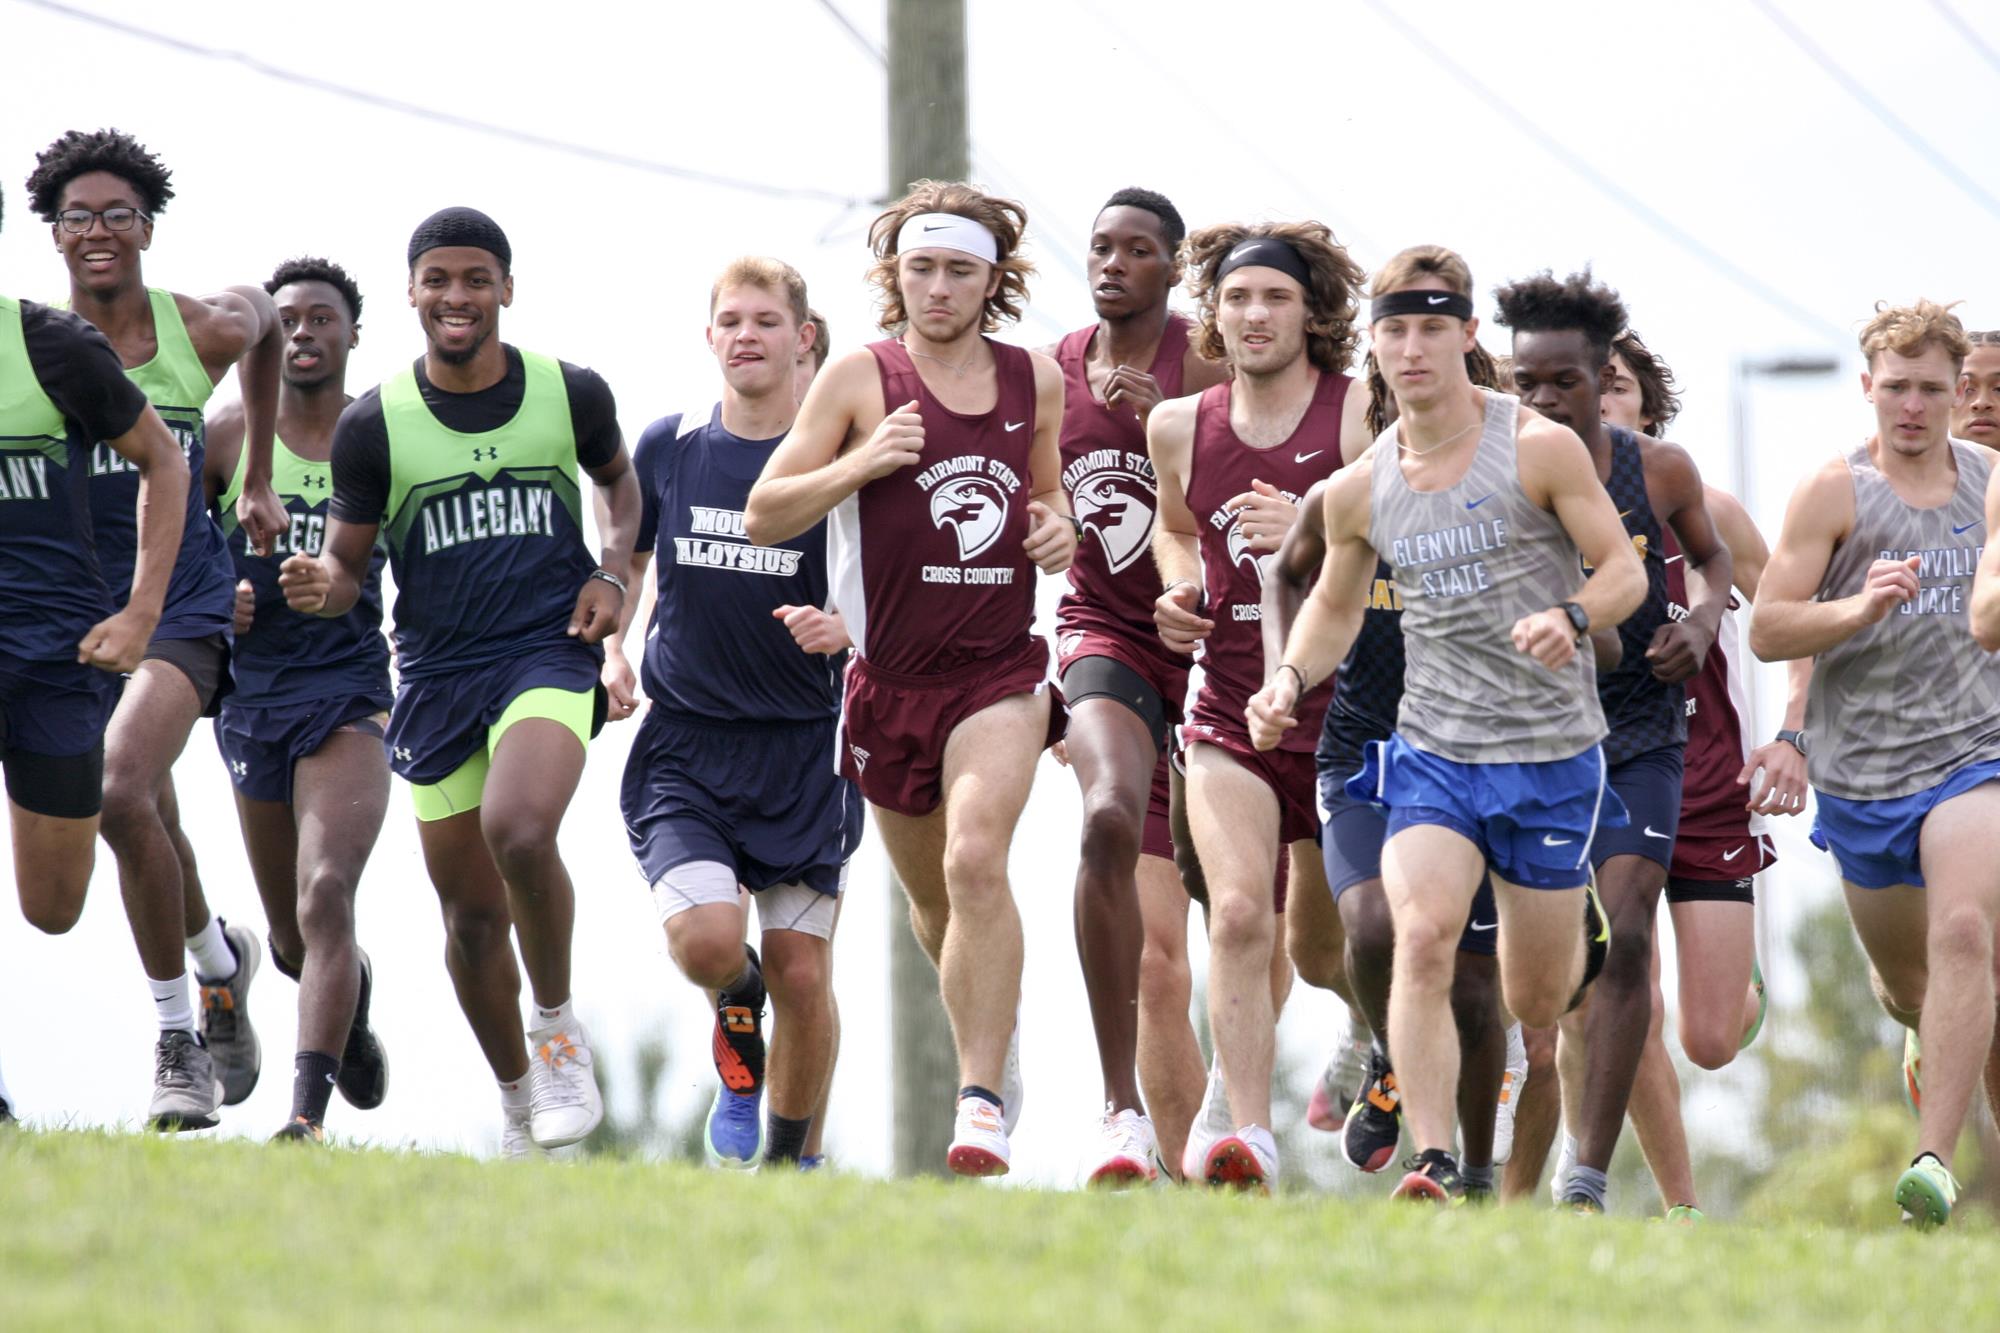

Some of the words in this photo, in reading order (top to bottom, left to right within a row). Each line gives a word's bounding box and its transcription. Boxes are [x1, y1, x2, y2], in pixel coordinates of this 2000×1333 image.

[914, 455, 985, 491] FAIRMONT
[988, 459, 1021, 493] STATE
[1062, 449, 1121, 492] FAIRMONT
[1125, 452, 1157, 481] STA
[422, 486, 554, 555] ALLEGANY
[690, 506, 750, 539] MOU
[674, 537, 804, 577] ALOYSIUS
[1393, 519, 1506, 567] GLENVILLE
[922, 565, 961, 583] CROSS
[963, 567, 1015, 584] COUNTRY
[1422, 561, 1490, 599] STATE
